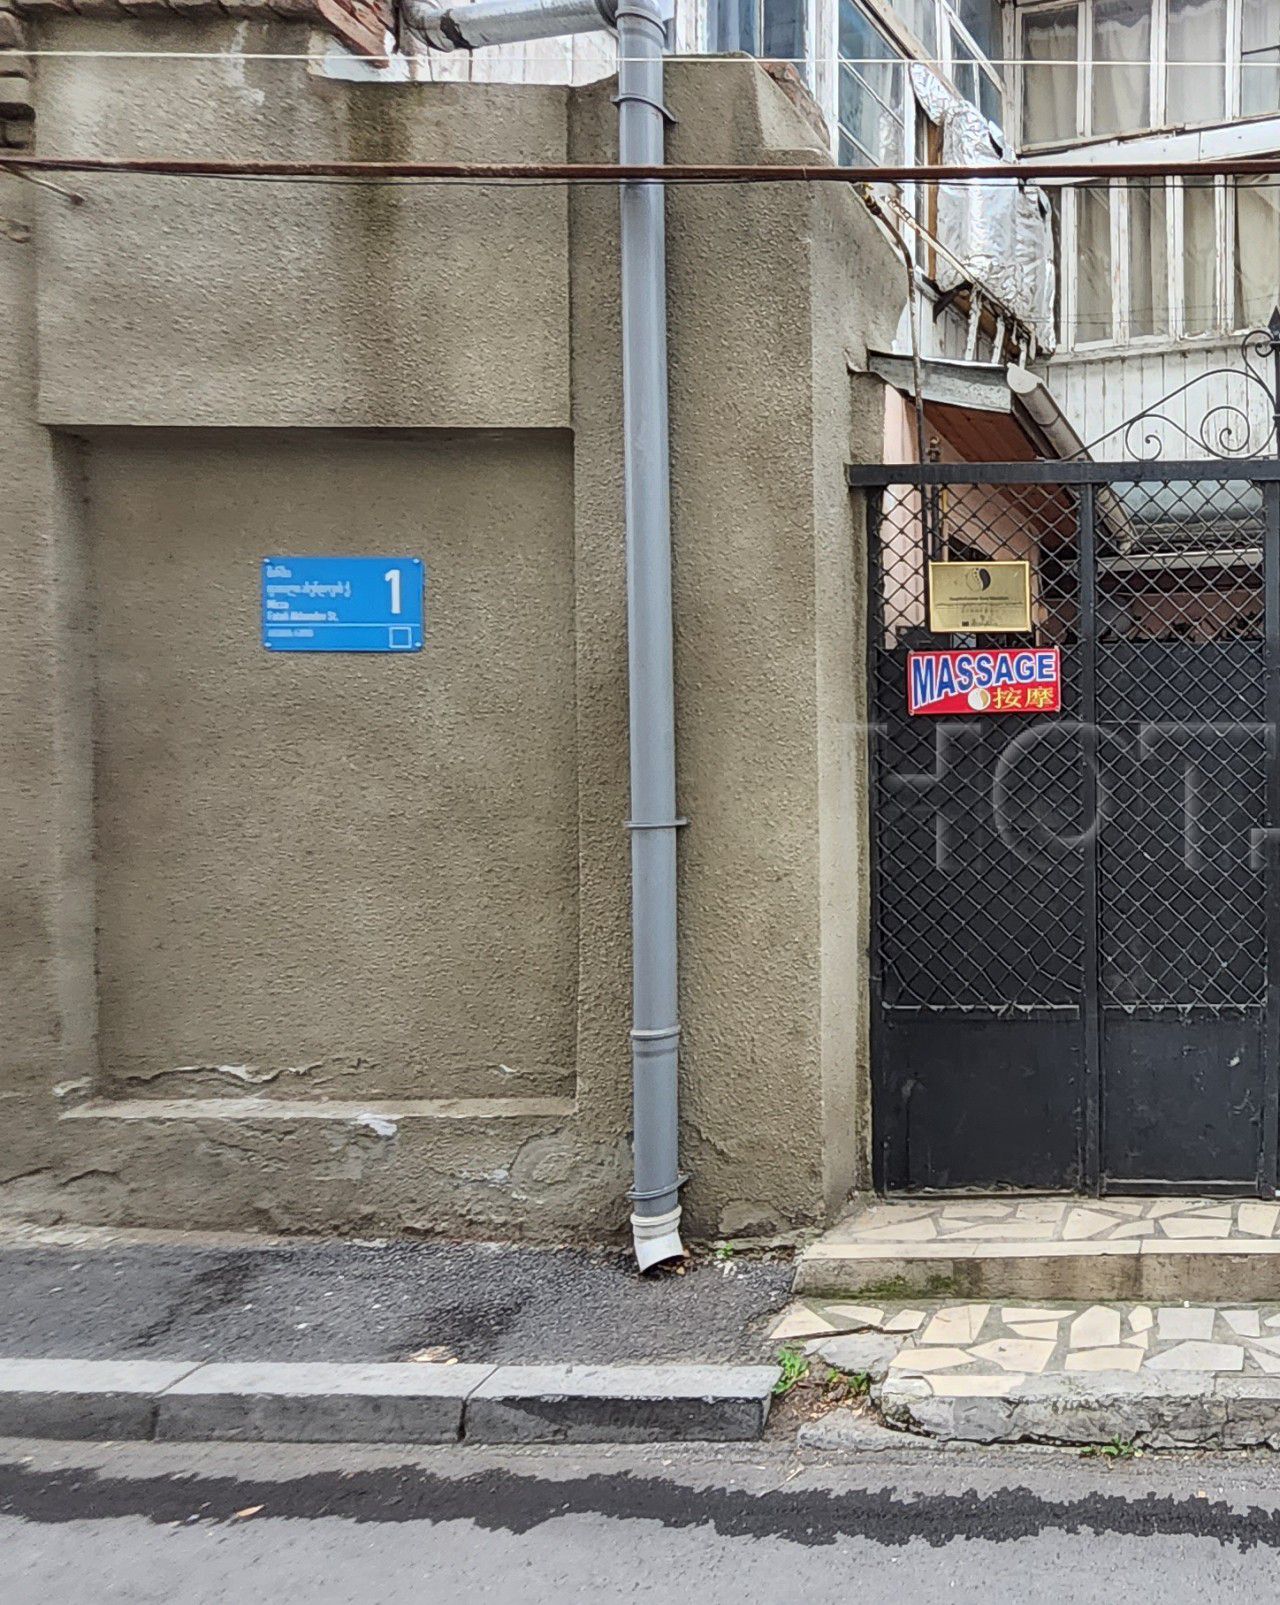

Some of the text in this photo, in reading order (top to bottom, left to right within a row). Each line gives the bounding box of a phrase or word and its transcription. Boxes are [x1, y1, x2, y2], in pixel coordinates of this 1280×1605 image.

[385, 569, 401, 614] 1
[911, 653, 1057, 710] MASSAGE
[992, 686, 1055, 709] 按摩
